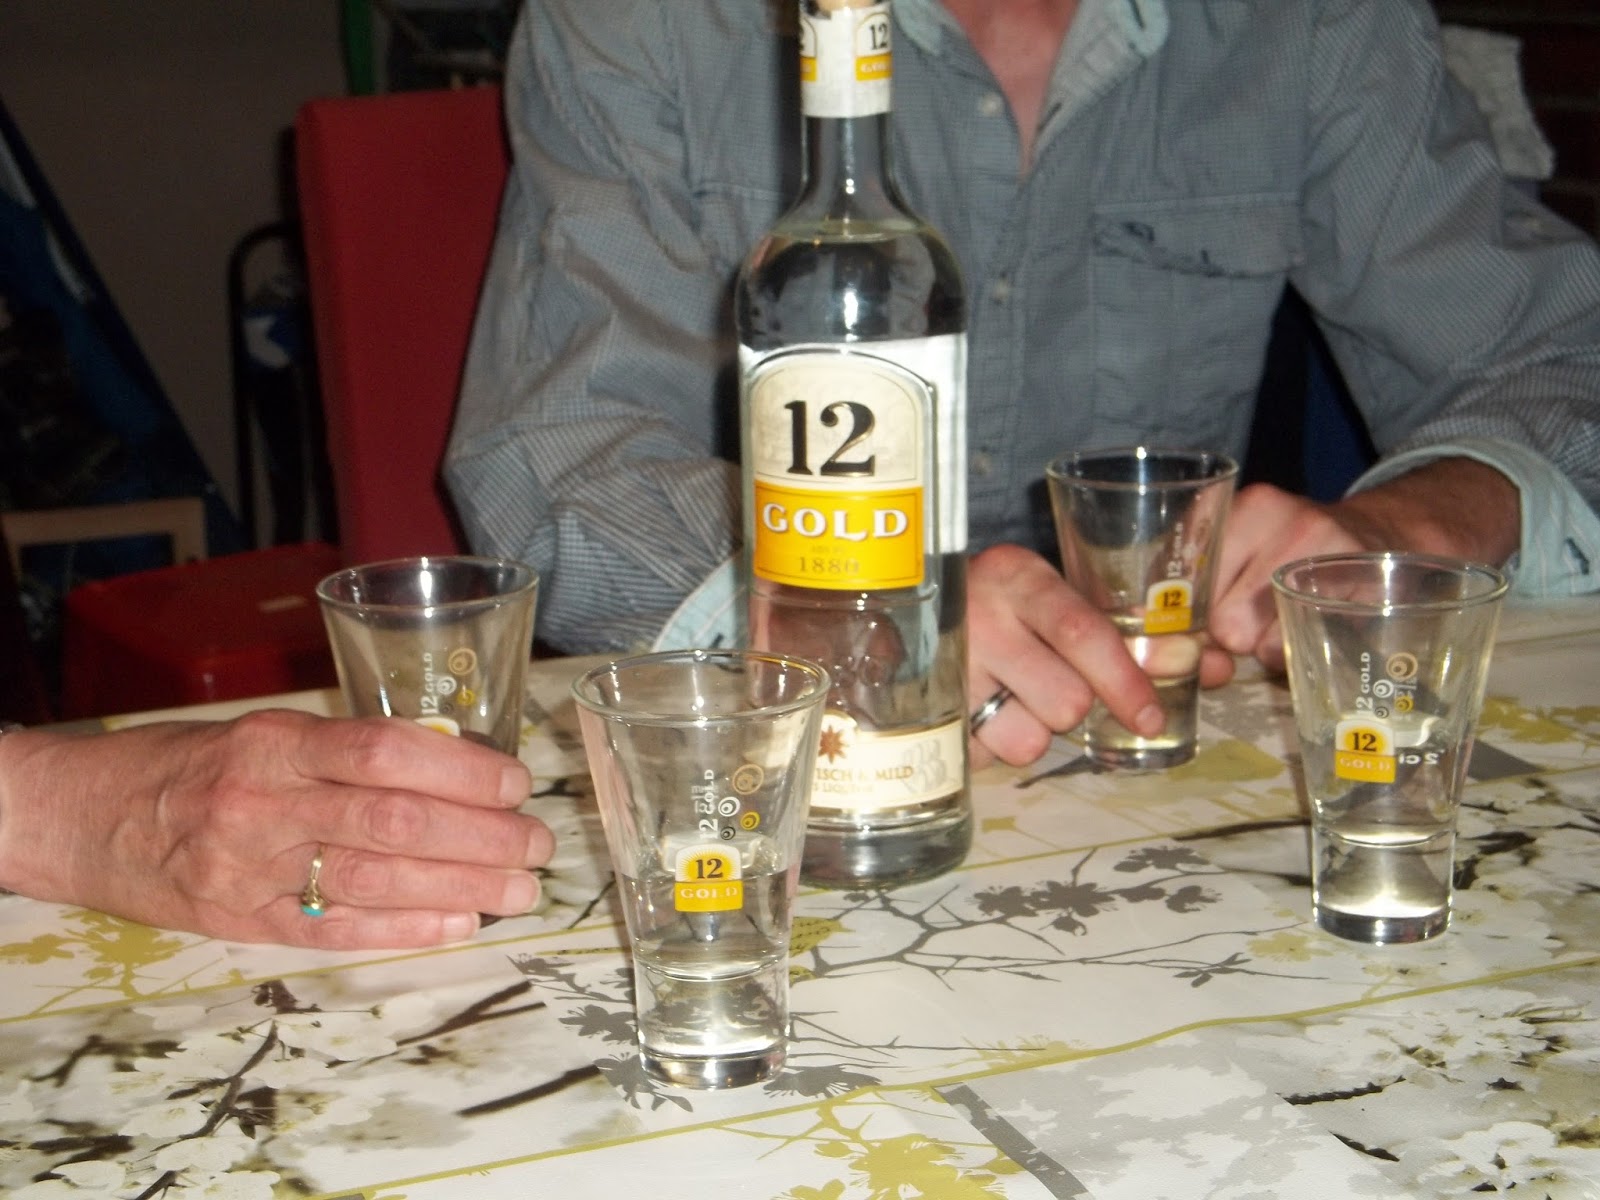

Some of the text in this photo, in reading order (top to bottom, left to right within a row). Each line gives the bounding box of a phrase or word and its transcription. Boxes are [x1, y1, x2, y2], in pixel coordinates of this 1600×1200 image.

[869, 23, 888, 50] 12
[784, 400, 876, 477] 12
[762, 503, 909, 542] GOLD
[1163, 590, 1182, 607] 12
[421, 652, 439, 715] 12 GOLD
[1360, 652, 1371, 693] GOLD
[1352, 732, 1377, 752] 12
[815, 767, 852, 781] ISCH
[875, 765, 914, 780] MILD
[704, 769, 715, 814] GOLD
[698, 818, 719, 839] 12
[696, 858, 723, 880] 12
[680, 886, 738, 899] GOLD
